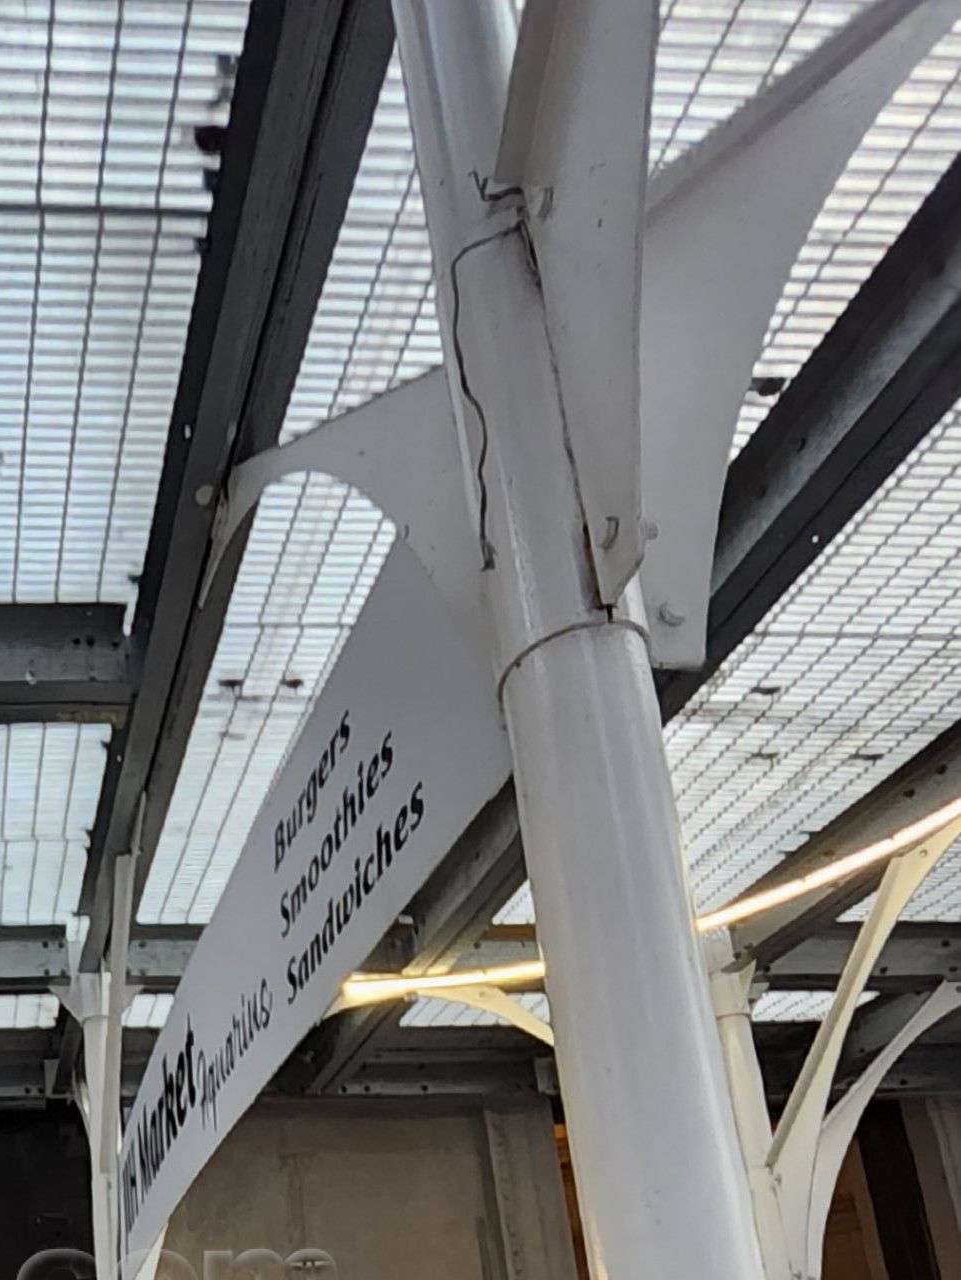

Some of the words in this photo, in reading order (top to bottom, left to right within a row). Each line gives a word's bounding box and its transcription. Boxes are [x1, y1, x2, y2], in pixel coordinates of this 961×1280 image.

[274, 708, 350, 874] Burgers
[279, 729, 394, 939] Smoothies
[286, 780, 425, 1005] Sandwiches
[137, 1012, 196, 1205] Market
